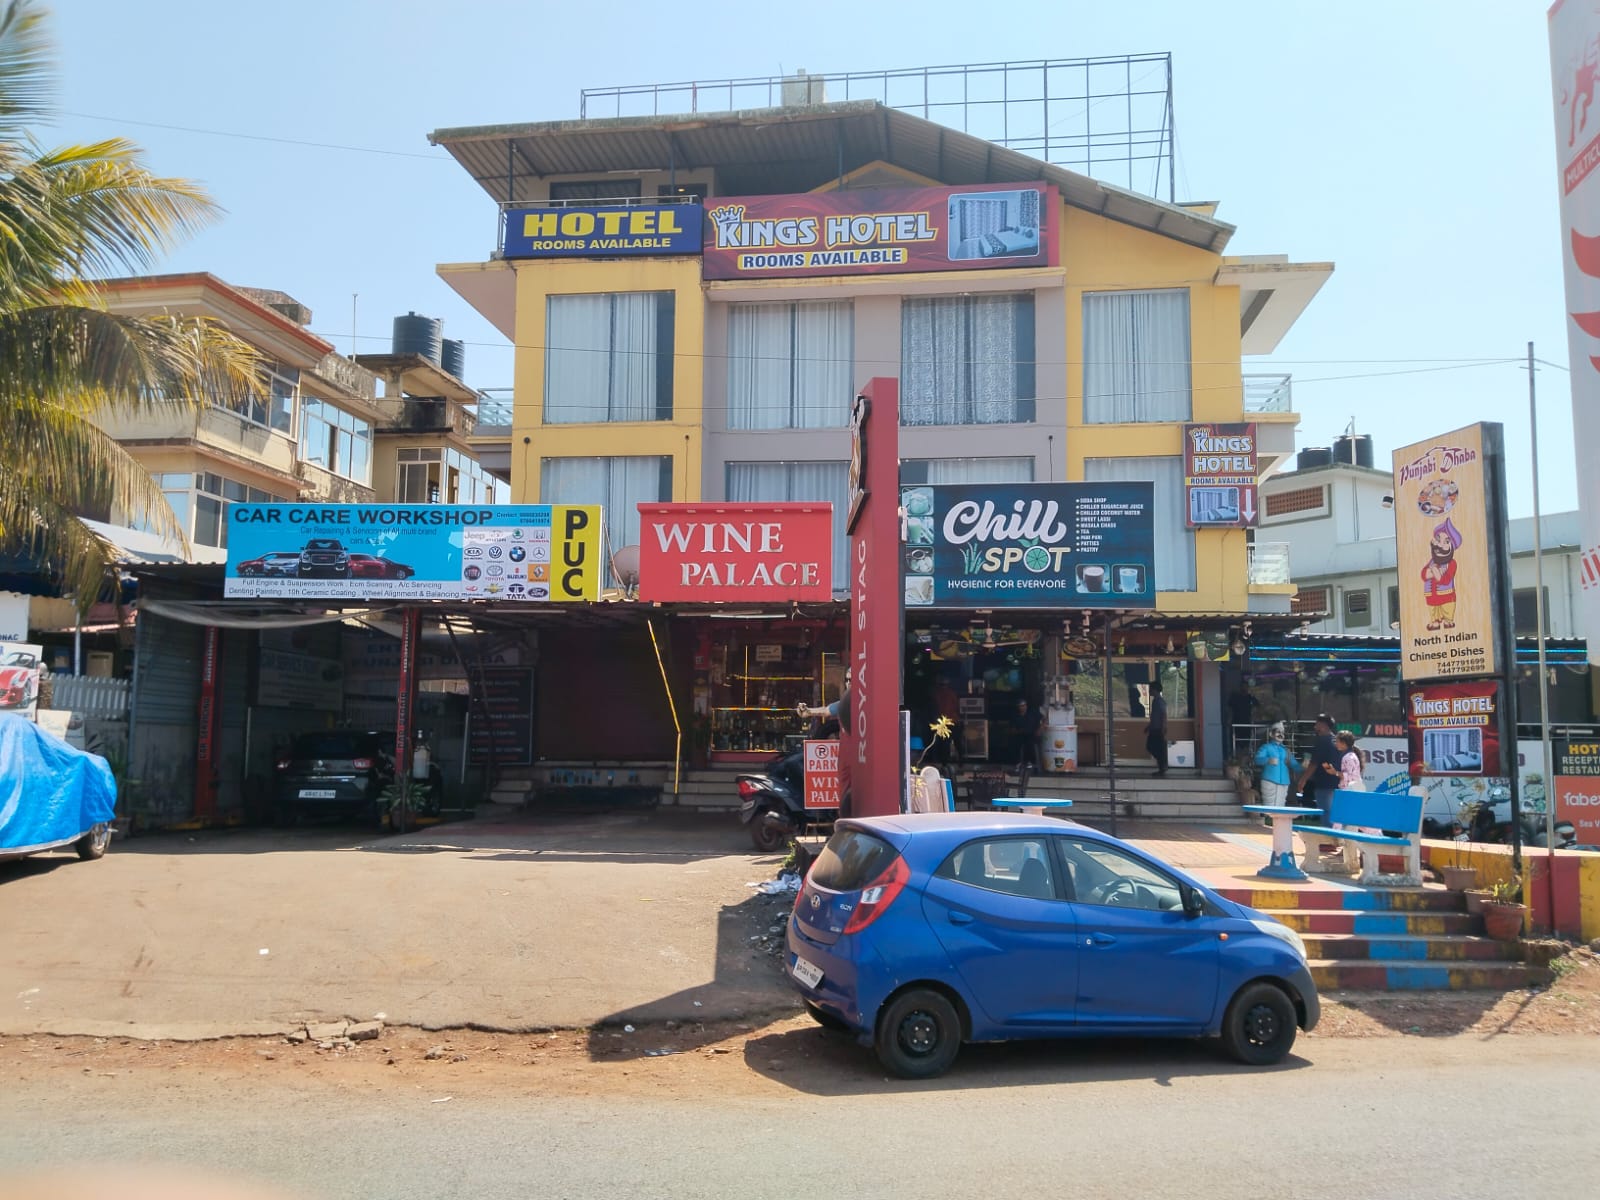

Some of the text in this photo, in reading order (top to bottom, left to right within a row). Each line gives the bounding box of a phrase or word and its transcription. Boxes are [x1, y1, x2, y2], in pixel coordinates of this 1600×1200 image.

[523, 210, 682, 237] HOTEL
[718, 213, 938, 249] KINGS HOTEL
[533, 238, 672, 250] ROOMS AVAILABLE
[743, 250, 901, 268] ROOMS AVAILABLE
[1194, 437, 1253, 453] KINGS
[1193, 456, 1255, 474] HOTEL
[1400, 448, 1476, 486] Punjabi Dhaba
[1190, 476, 1254, 485] ROOMS AVAILABLE
[234, 508, 493, 525] CAR CARE WORKSHOP
[943, 499, 1067, 544] Chill
[417, 527, 437, 536] brand
[652, 522, 784, 553] WINE
[562, 510, 588, 597] PUC
[982, 546, 1071, 573] SPOT
[679, 562, 820, 587] PALACE
[256, 579, 279, 588] Engine
[411, 581, 442, 590] Servicing
[948, 579, 1067, 589] HYGIENIC FOR EVERYONE
[255, 588, 282, 597] Painting
[301, 589, 331, 597] Ceramic
[384, 590, 418, 598] Alignment
[1414, 631, 1478, 647] North Indian
[857, 539, 867, 764] ROYAL STAG
[1409, 647, 1485, 662] Chinese Dishes
[1414, 696, 1495, 715] KINGS HOTEL
[1419, 716, 1486, 727] ROOMS AVAILABLE
[1568, 744, 1600, 755] HOT
[1563, 792, 1600, 806] fabe
